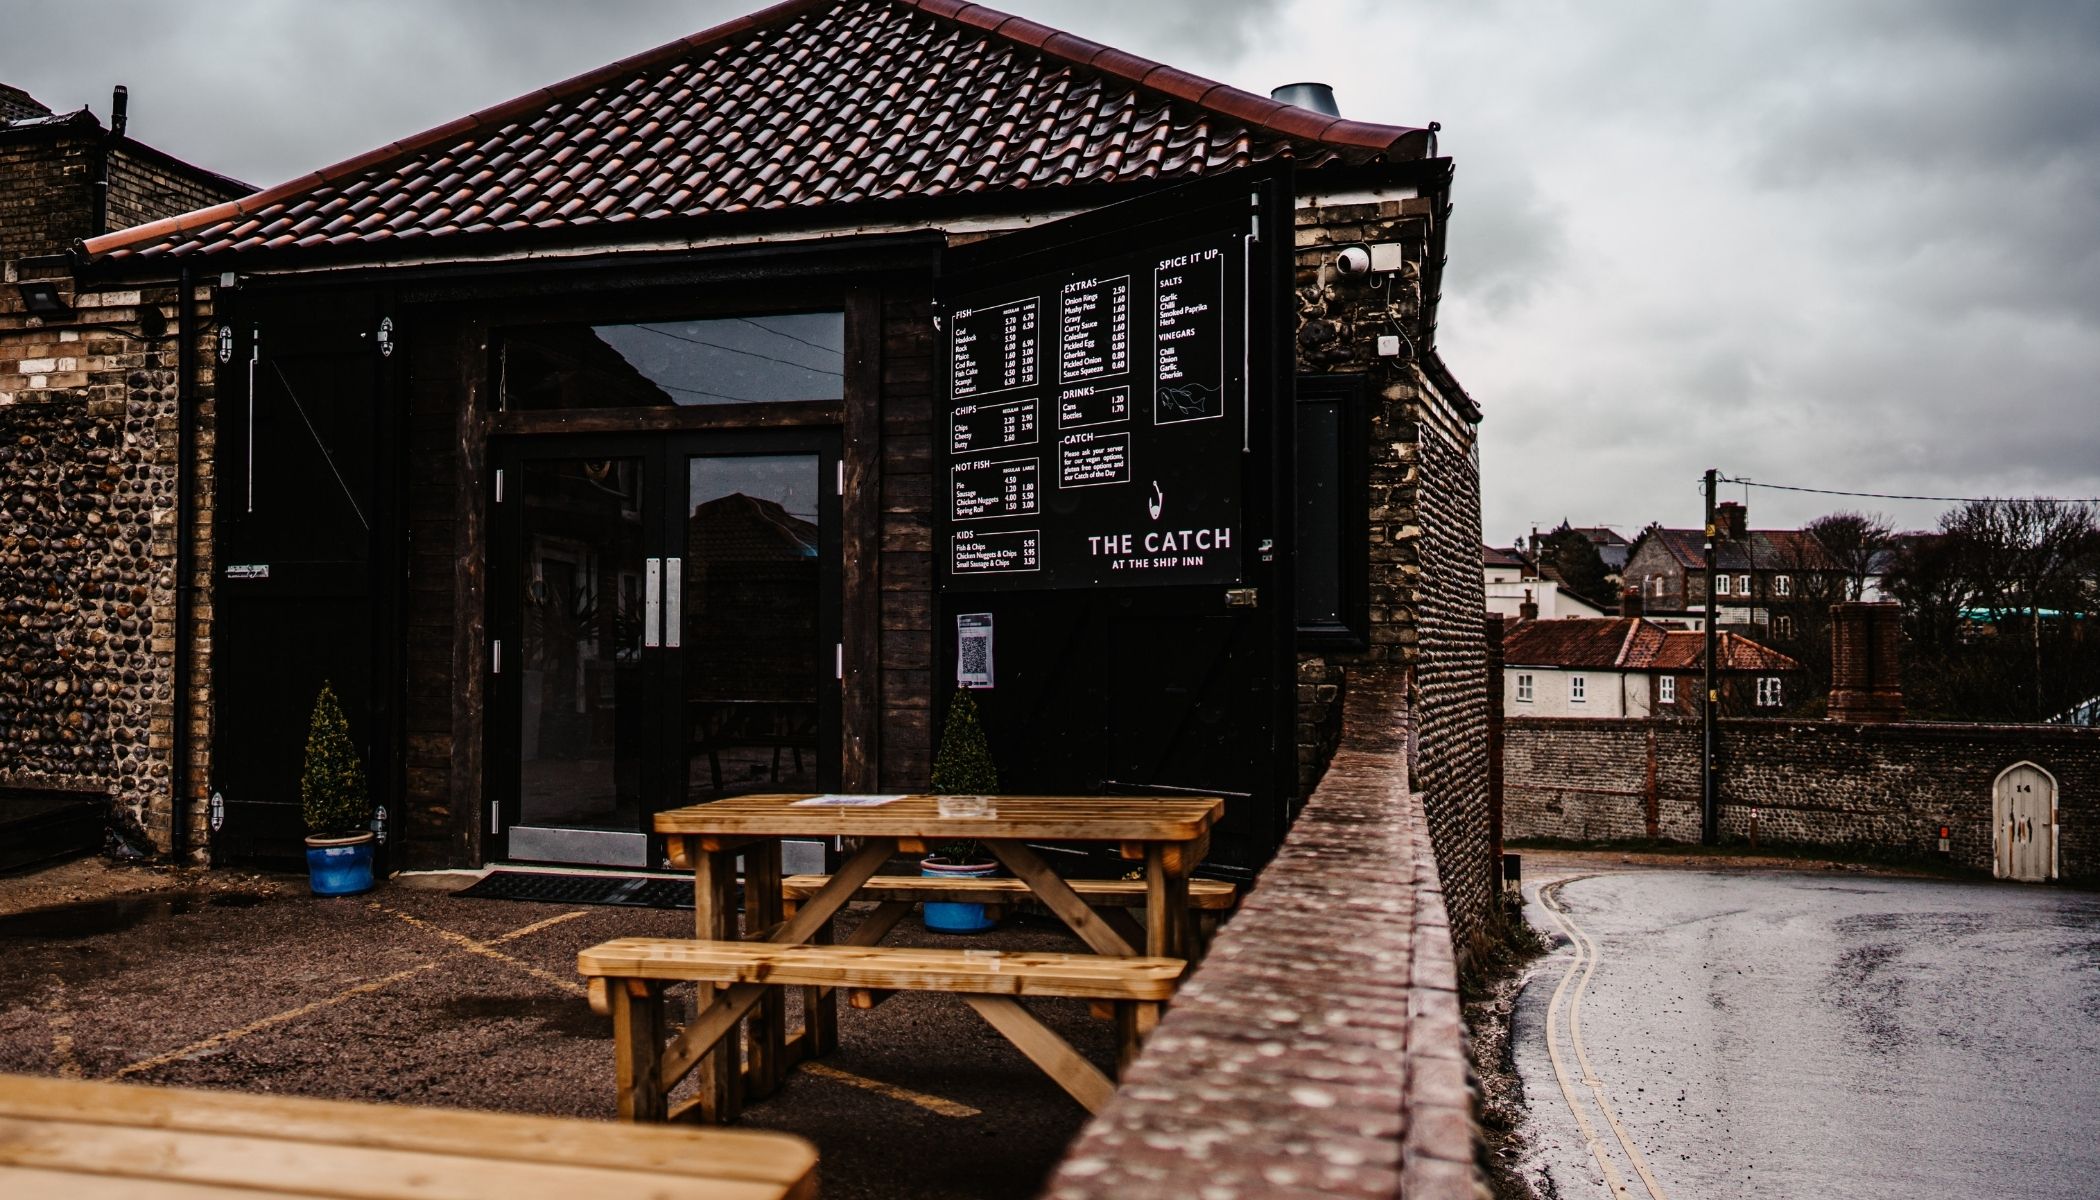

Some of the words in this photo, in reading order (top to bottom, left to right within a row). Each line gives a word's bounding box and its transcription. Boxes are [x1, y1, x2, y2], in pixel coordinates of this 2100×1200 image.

[1160, 256, 1187, 270] SPICE
[1190, 253, 1200, 263] IT
[1204, 249, 1218, 260] UP
[1065, 278, 1097, 293] EXTRAS
[1160, 277, 1182, 287] SALTS
[1065, 297, 1082, 305] Onion
[1083, 294, 1098, 302] Rings
[1113, 286, 1125, 295] 2.50
[1160, 293, 1177, 302] Garlic
[1003, 307, 1019, 315] REGULAR
[1065, 306, 1082, 315] Mushy
[1083, 303, 1095, 311] Peas
[1113, 295, 1125, 304] 1.60
[1160, 301, 1175, 310] Chilli
[1160, 308, 1183, 318] Smoked
[1185, 304, 1207, 314] Paprika
[956, 309, 971, 319] FISH
[1065, 316, 1081, 324] Gravy
[1113, 305, 1125, 313] 1.60
[956, 328, 966, 336] Cod
[1005, 317, 1016, 325] 5.70
[1023, 313, 1034, 321] 6.70
[1082, 321, 1097, 329] Sauce
[1113, 314, 1125, 322] 1.60
[1160, 318, 1175, 326] Herb
[956, 334, 976, 344] Haddock
[1005, 326, 1016, 334] 5.50
[1023, 322, 1034, 330] 6.50
[1005, 334, 1016, 342] 5.50
[1064, 332, 1088, 341] Coleslaw
[1113, 323, 1125, 332] 1.60
[1159, 328, 1195, 341] VINEGARS
[1064, 341, 1083, 350] Pickled
[1084, 340, 1094, 348] Egg
[1112, 332, 1125, 341] 0.85
[956, 353, 969, 361] Plaice
[1005, 343, 1016, 351] 6.00
[1022, 339, 1034, 348] 6.90
[1064, 350, 1086, 360] Gherkin
[1160, 347, 1174, 356] Chilli
[955, 361, 965, 369] Cod
[1022, 348, 1033, 356] 3.00
[1064, 359, 1083, 368] Pickled
[1084, 357, 1102, 365] Onion
[1160, 356, 1177, 364] Onion
[955, 370, 965, 378] Fish
[1006, 360, 1015, 368] 1.60
[1022, 357, 1033, 365] 3.00
[1064, 370, 1079, 378] Sauce
[1080, 366, 1103, 375] Squeeze
[1112, 361, 1124, 369] 0.60
[1160, 364, 1177, 372] Garlic
[955, 377, 972, 386] Scampi
[1005, 369, 1015, 377] 4.50
[1022, 366, 1033, 374] 6.50
[1160, 371, 1182, 380] Gherkin
[955, 385, 976, 394] Calamari
[1004, 378, 1015, 386] 6.50
[1022, 374, 1033, 382] 7.50
[1063, 387, 1094, 399] DRINKS
[1112, 395, 1124, 403] 1.20
[955, 405, 976, 416] CHIPS
[1063, 412, 1082, 420] Bottles
[1112, 405, 1124, 413] 1.70
[1021, 414, 1032, 422] 2.90
[955, 432, 972, 440] Cheesy
[1021, 422, 1032, 431] 3.90
[1004, 434, 1015, 442] 2.60
[1064, 433, 1093, 444] CATCH
[955, 462, 971, 472] NOT
[974, 460, 990, 470] FISH
[1086, 456, 1100, 464] vegan
[956, 490, 976, 498] Sausage
[1022, 483, 1034, 491] 1.80
[978, 497, 999, 505] Nuggets
[1022, 492, 1034, 500] 5.50
[956, 507, 972, 515] Spring
[1022, 501, 1034, 509] 3.00
[957, 531, 973, 539] KIDS
[1088, 534, 1132, 555] THE
[1144, 528, 1231, 552] CATCH
[977, 551, 996, 560] Nuggets
[1002, 550, 1017, 558] Chips
[995, 559, 1009, 567] Chips
[1112, 560, 1125, 569] AT
[1129, 559, 1149, 568] THE
[1153, 558, 1178, 568] SHIP
[1182, 556, 1203, 566] INN
[2016, 785, 2031, 793] 14
